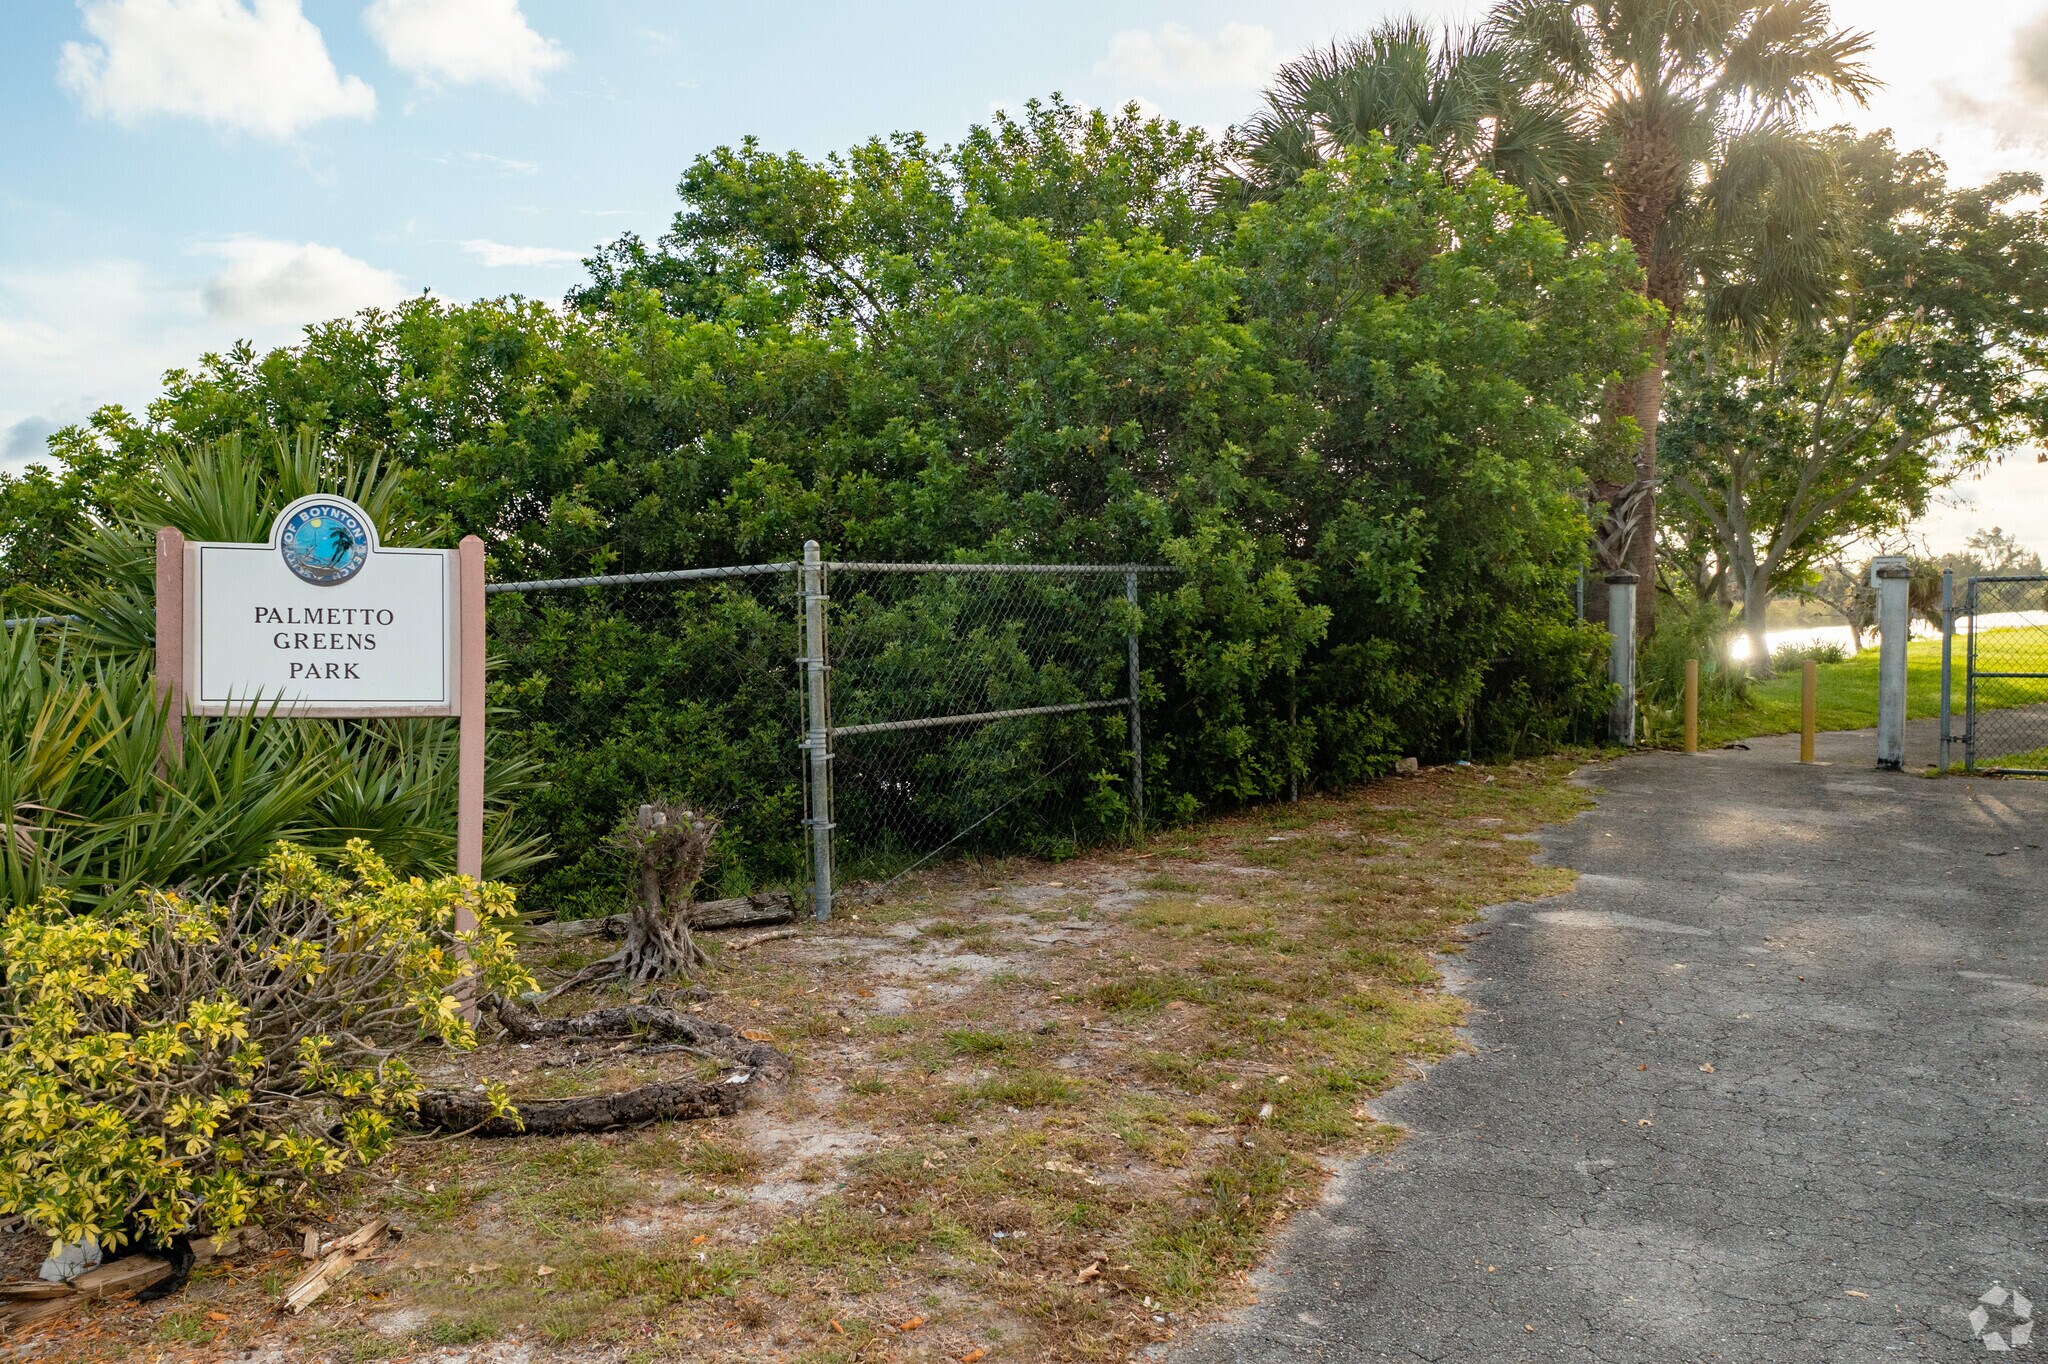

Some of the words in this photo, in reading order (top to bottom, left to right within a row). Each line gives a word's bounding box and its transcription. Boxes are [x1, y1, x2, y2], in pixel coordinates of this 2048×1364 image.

[284, 524, 296, 542] OF
[299, 507, 363, 538] BOYNTON
[333, 544, 366, 579] EACH
[255, 606, 394, 626] PALMETTO
[273, 632, 376, 651] GREENS
[289, 662, 360, 680] PARK
